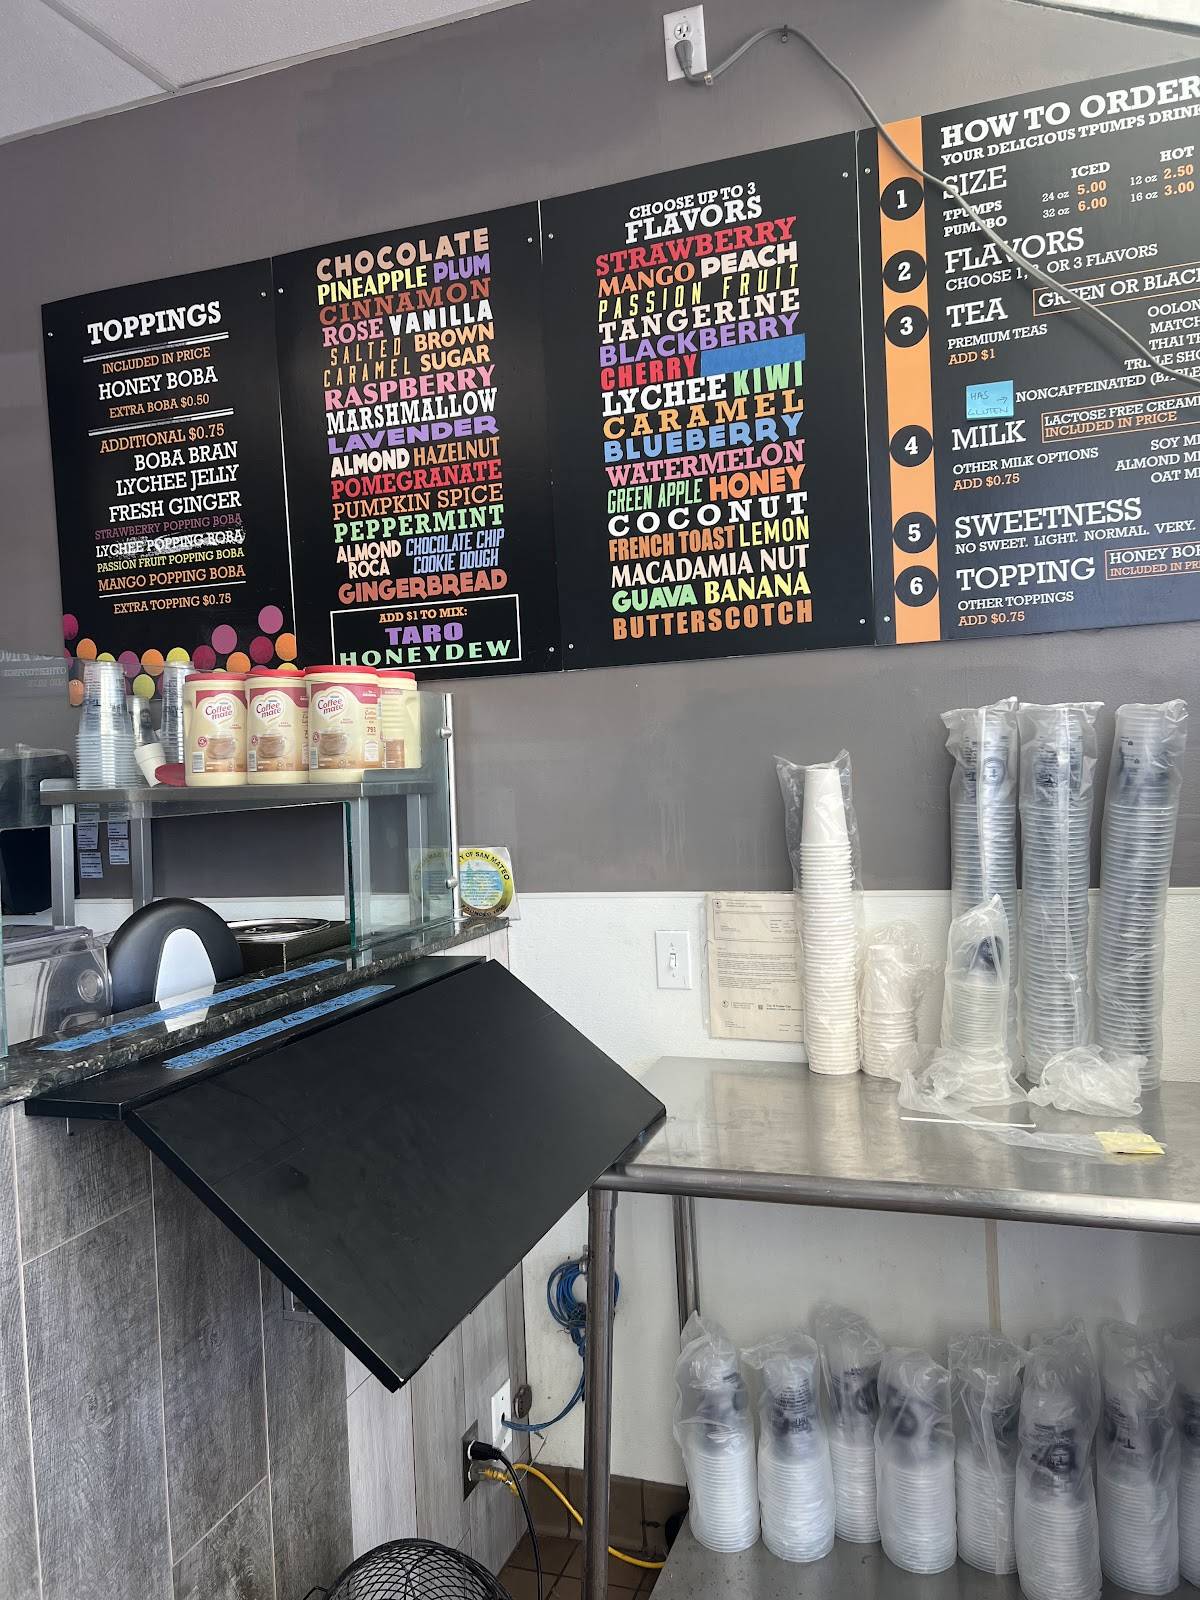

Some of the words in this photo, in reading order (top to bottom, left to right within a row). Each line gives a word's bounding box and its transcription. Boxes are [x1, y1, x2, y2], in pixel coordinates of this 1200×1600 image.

[940, 111, 1019, 149] HOW
[1023, 102, 1071, 131] TO
[1080, 75, 1200, 119] ORDER
[941, 146, 985, 167] YOUR
[987, 128, 1076, 157] DELICIOUS
[1078, 114, 1145, 139] TPUMPS
[1160, 145, 1195, 163] HOT
[942, 165, 1007, 199] SIZE
[1071, 161, 1110, 179] ICED
[1163, 163, 1194, 180] 2.50
[629, 196, 694, 220] CHOOSE
[697, 191, 719, 206] UP
[720, 184, 744, 201] TO
[747, 181, 756, 195] 3
[896, 190, 907, 209] 1
[1077, 179, 1107, 195] 5.00
[1164, 180, 1195, 196] 3.00
[1077, 196, 1108, 212] 6.00
[624, 195, 763, 245] FLAVORS
[316, 227, 489, 282] CHOCOLATE
[595, 215, 797, 277] STRAWBERRY
[317, 265, 428, 305] PINEAPPLE
[433, 252, 491, 283] PLUM
[598, 261, 695, 298] MANGO
[700, 240, 798, 279] PEACH
[898, 262, 911, 281] 2
[945, 268, 1012, 292] CHOOSE
[1086, 243, 1159, 268] FLAVORS
[319, 277, 491, 326] CINNAMON
[598, 281, 702, 322] PASSION
[722, 263, 799, 300] FRUIT
[87, 300, 222, 345] TOPPINGS
[322, 317, 384, 348] ROSE
[389, 299, 493, 336] VANILLA
[598, 287, 800, 345] TANGERINE
[900, 316, 913, 336] 3
[946, 297, 1008, 328] TEA
[330, 337, 401, 366] SALTED
[414, 321, 495, 353] BROWN
[599, 311, 800, 368] BLACKBERRY
[947, 329, 1011, 350] PREMIUM
[1012, 323, 1048, 341] TEAS
[102, 355, 159, 374] INCLUDED
[162, 353, 174, 364] IN
[177, 346, 211, 362] PRICE
[323, 357, 411, 388] CARAMEL
[419, 345, 491, 373] SUGAR
[600, 353, 698, 391] CHERRY
[948, 350, 978, 367] ADD
[980, 348, 996, 361] $1
[98, 374, 163, 400] HONEY
[166, 366, 218, 390] BOBA
[324, 364, 496, 411] RASPBERRY
[601, 373, 727, 417] LYCHEE
[733, 360, 804, 397] KIWI
[1015, 374, 1146, 403] NONCAFFEINATED
[109, 403, 146, 419] EXTRA
[147, 398, 178, 413] BOBA
[180, 393, 210, 408] $0.50
[326, 387, 498, 436] MARSHMALLOW
[602, 388, 804, 440] CARAMEL
[1044, 409, 1106, 427] LACTOSE
[1109, 403, 1144, 419] FREE
[100, 429, 186, 453] ADDITIONAL
[188, 423, 225, 442] $0.75
[328, 415, 499, 455] LAVENDER
[603, 411, 804, 463] BLUEBERRY
[952, 419, 1027, 451] MILK
[1045, 420, 1114, 438] INCLUDED
[1117, 416, 1132, 429] IN
[1135, 411, 1178, 426] PRICE
[134, 449, 185, 471] BOBA
[188, 441, 238, 464] BRAN
[330, 447, 410, 478] ALMOND
[413, 436, 500, 467] HAZELNUT
[904, 436, 919, 455] 4
[605, 438, 806, 488] WATERMELON
[953, 459, 999, 476] OTHER
[1001, 454, 1035, 470] MILK
[1036, 447, 1099, 466] OPTIONS
[116, 471, 187, 496] LYCHEE
[190, 464, 239, 491] JELLY
[331, 459, 503, 500] POMEGRANATE
[607, 484, 653, 514] GREEN
[657, 478, 704, 509] APPLE
[708, 463, 806, 502] HONEY
[953, 477, 983, 491] ADD
[985, 473, 1020, 488] $0.75
[109, 500, 164, 523] FRESH
[168, 491, 242, 515] GINGER
[332, 492, 431, 521] PUMPKIN
[437, 482, 504, 509] SPICE
[608, 491, 808, 537] COCONUT
[95, 522, 161, 540] STRAWBERRY
[163, 517, 211, 532] POPPING
[213, 513, 242, 525] BOBA
[333, 503, 504, 544] PEPPERMINT
[908, 523, 921, 542] 5
[954, 497, 1142, 539] SWEETNESS
[336, 540, 402, 563] ALMOND
[405, 532, 473, 557] CHOCOLATE
[475, 527, 505, 549] CHIP
[608, 532, 675, 562] FRENCH
[677, 524, 736, 554] TOAST
[739, 514, 810, 548] LEMON
[955, 543, 976, 555] NO
[979, 537, 1028, 553] SWEET.
[1034, 532, 1079, 547] LIGHT.
[1084, 525, 1150, 541] NORMAL.
[1154, 520, 1196, 534] VERY.
[97, 559, 137, 573] PASSION
[139, 556, 167, 568] FRUIT
[169, 551, 214, 565] POPPING
[216, 547, 245, 559] BOBA
[348, 559, 390, 579] ROCA
[413, 551, 455, 575] COOKIE
[459, 547, 499, 570] DOUGH
[611, 550, 754, 588] MACADAMIA
[760, 543, 810, 572] NUT
[956, 557, 1096, 591] TOPPING
[98, 575, 146, 592] MANGO
[149, 568, 206, 586] POPPING
[209, 564, 246, 580] BOBA
[338, 568, 508, 604] GINGERBREAD
[611, 583, 698, 613] GUAVA
[704, 571, 811, 605] BANANA
[910, 577, 923, 595] 6
[113, 601, 149, 614] EXTRA
[150, 595, 200, 611] TOPPING
[202, 592, 232, 606] $0.75
[378, 611, 404, 624] ADD
[406, 609, 418, 622] $1
[421, 608, 436, 620] TO
[439, 606, 468, 618] MIX:
[958, 596, 1003, 611] OTHER
[1005, 590, 1074, 606] TOPPINGS
[385, 621, 464, 646] TARO
[612, 598, 813, 641] BUTTERSCOTCH
[958, 613, 987, 626] ADD
[990, 611, 1025, 625] $0.75
[340, 639, 511, 667] HONEYDEW
[205, 703, 232, 716] Coffee
[211, 710, 232, 720] mate
[256, 702, 280, 714] Coffee
[261, 709, 281, 718] mate
[317, 698, 343, 710] Coffee
[475, 851, 490, 860] SAN
[490, 856, 510, 880] MATEO
